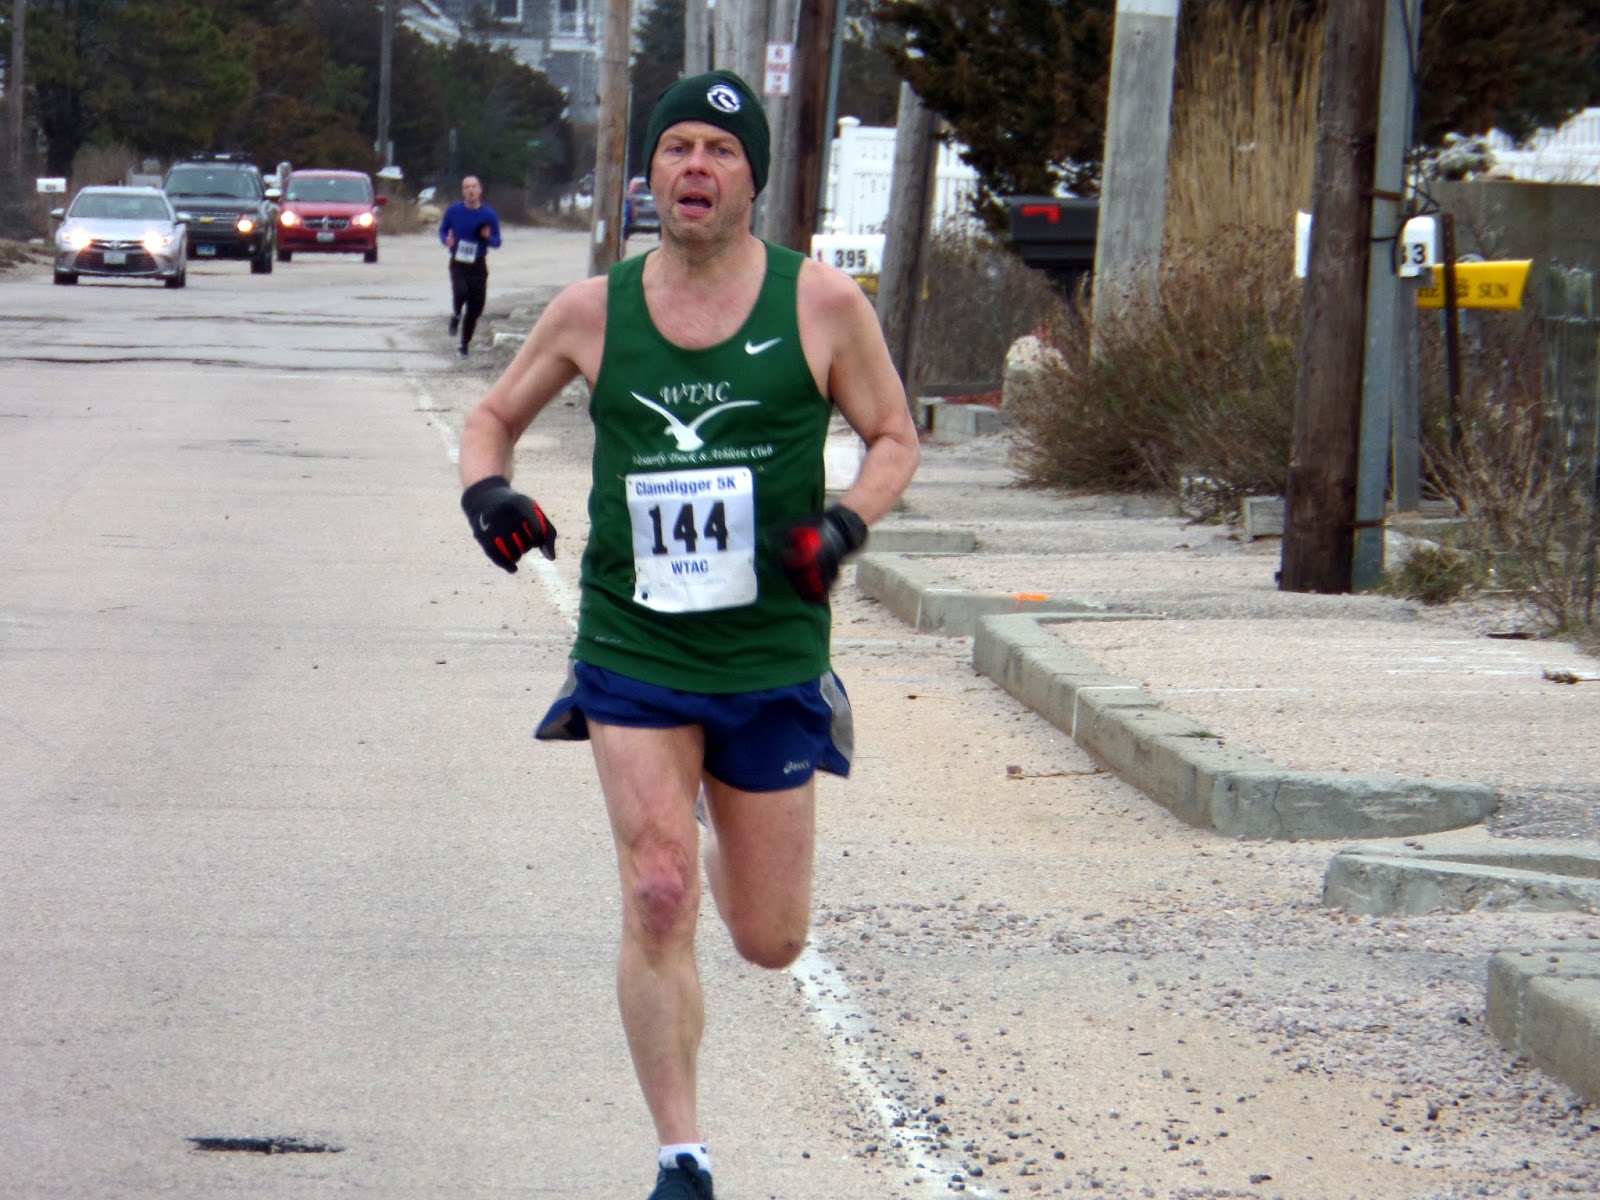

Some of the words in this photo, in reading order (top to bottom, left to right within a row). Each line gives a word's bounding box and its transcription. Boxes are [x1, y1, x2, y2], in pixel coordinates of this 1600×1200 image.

[834, 249, 867, 268] 395
[659, 381, 730, 405] WTAC
[635, 478, 712, 496] Clamdigger
[717, 475, 737, 490] 5K
[648, 500, 728, 555] 144
[671, 560, 709, 575] WTAC
